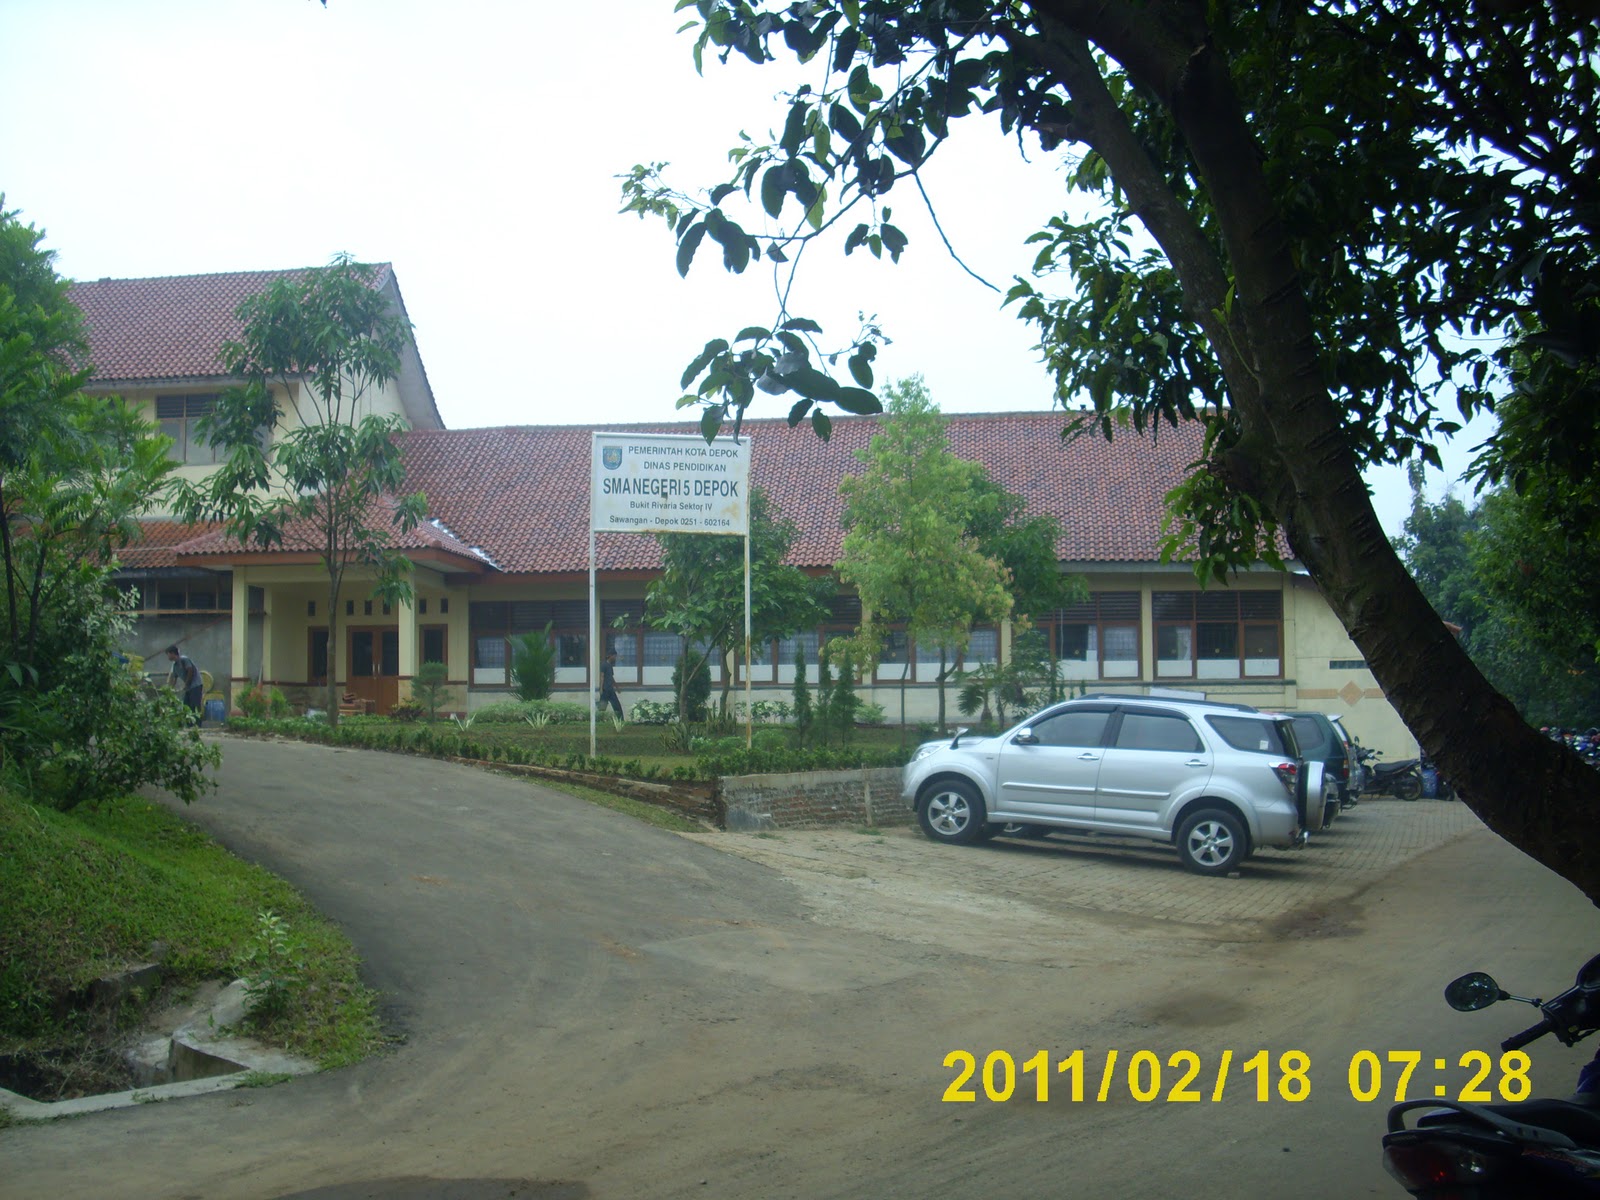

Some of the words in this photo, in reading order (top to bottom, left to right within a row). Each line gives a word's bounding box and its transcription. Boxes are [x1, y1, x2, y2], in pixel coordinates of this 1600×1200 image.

[628, 446, 683, 455] PEMERINTAH
[684, 448, 707, 457] KOTA
[709, 449, 738, 458] DEPOK
[643, 461, 671, 470] DINAS
[673, 462, 726, 472] PENDIDIKAN
[683, 480, 690, 496] 5
[694, 480, 738, 497] DEPOK
[630, 501, 650, 509] Bukit
[651, 501, 677, 510] Rivaria
[679, 502, 703, 511] Sektor
[705, 503, 713, 511] IV
[609, 515, 648, 525] Sawangan
[655, 517, 679, 526] Depok
[680, 517, 697, 526] 0251
[704, 518, 730, 527] 602164
